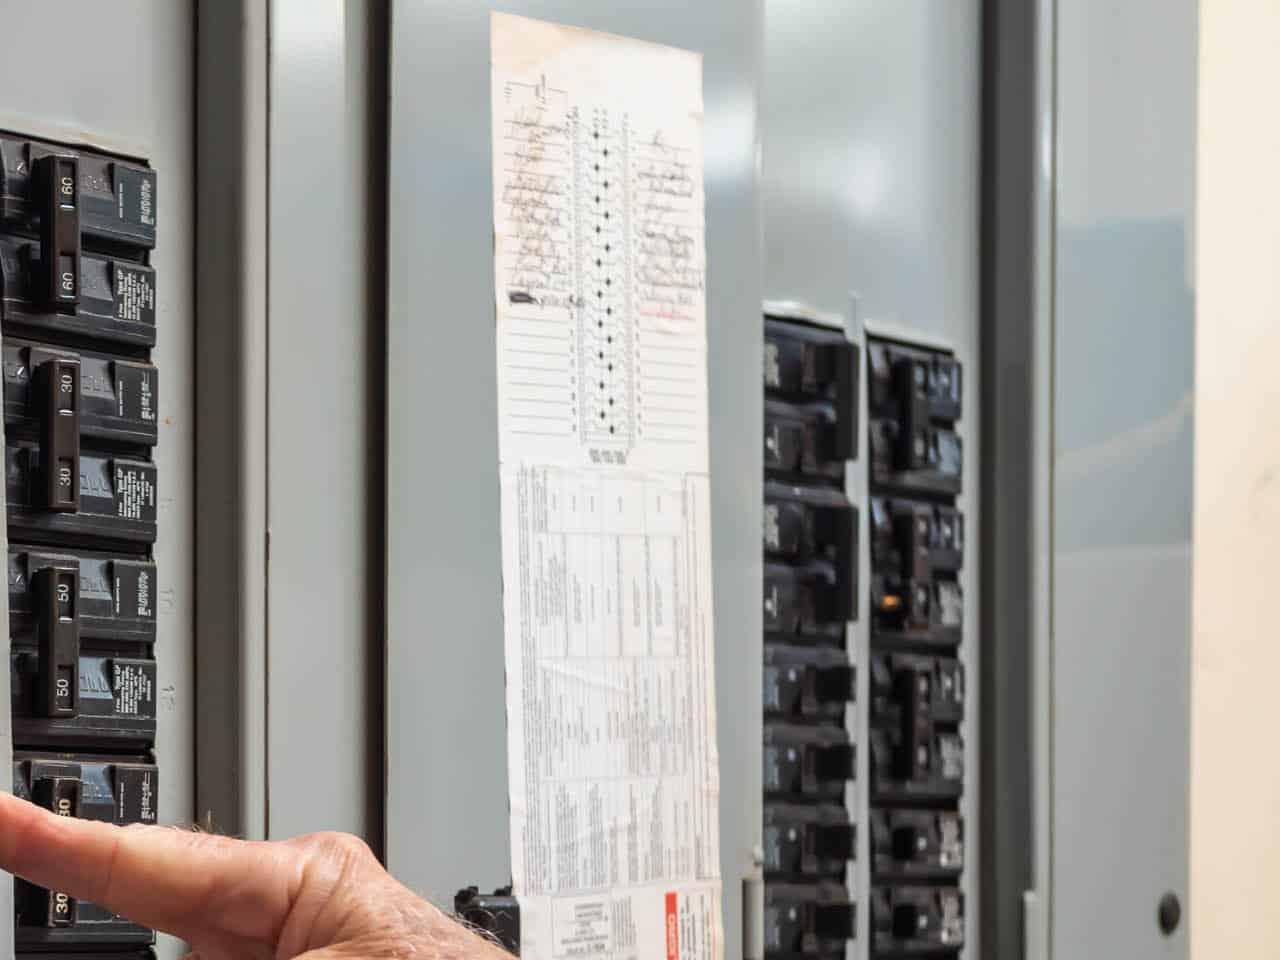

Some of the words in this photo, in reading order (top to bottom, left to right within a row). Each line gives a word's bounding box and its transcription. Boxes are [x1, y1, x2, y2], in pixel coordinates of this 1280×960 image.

[61, 177, 73, 195] 60
[62, 272, 73, 290] 60
[60, 375, 73, 393] 30
[60, 467, 72, 486] 30
[56, 584, 69, 602] 50
[56, 679, 69, 697] 50
[56, 893, 68, 913] 30
